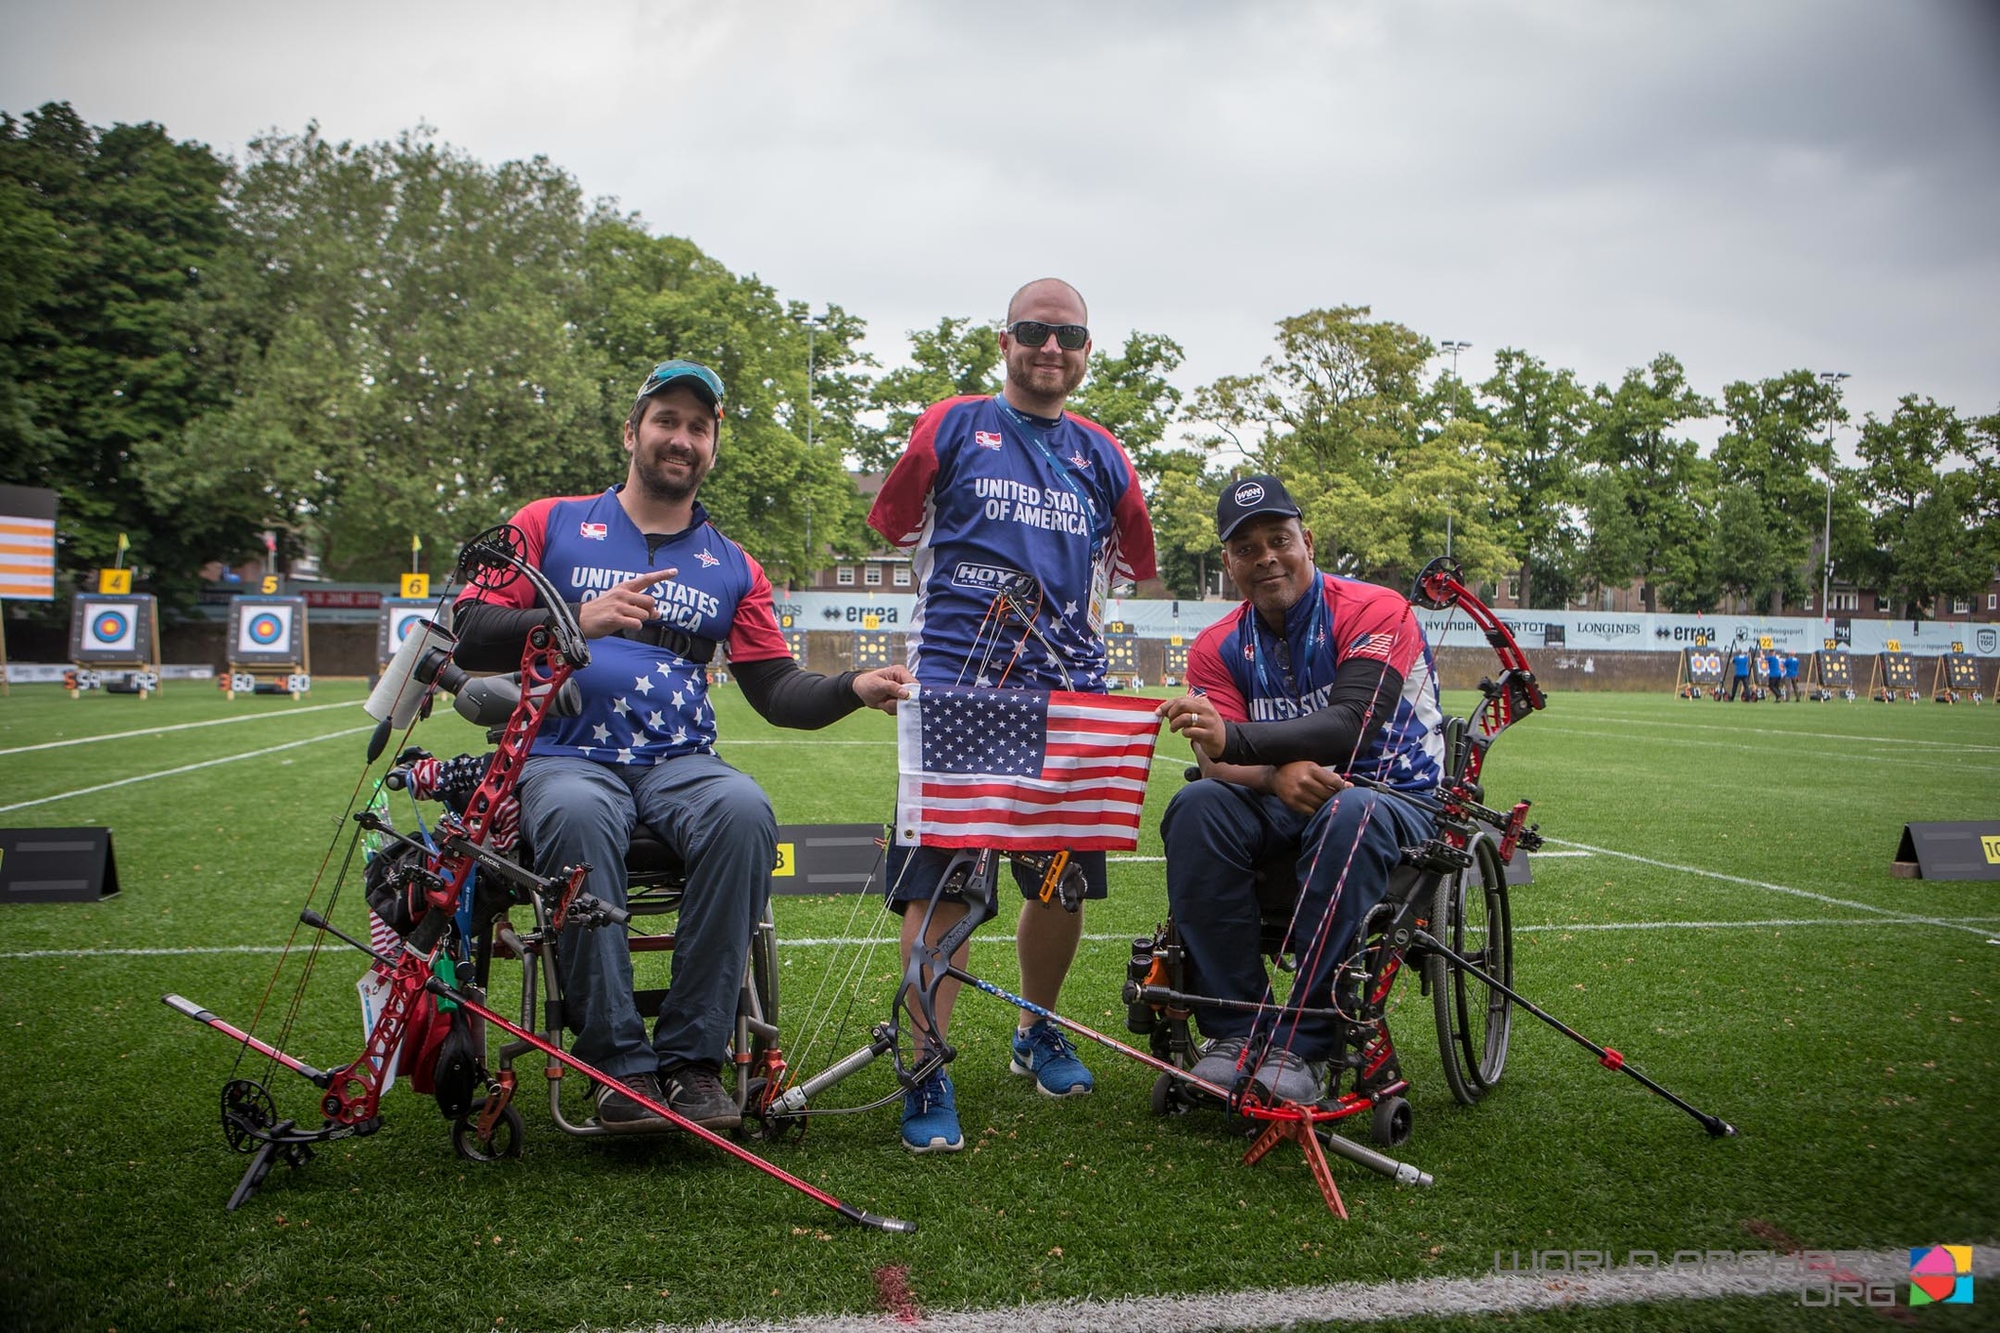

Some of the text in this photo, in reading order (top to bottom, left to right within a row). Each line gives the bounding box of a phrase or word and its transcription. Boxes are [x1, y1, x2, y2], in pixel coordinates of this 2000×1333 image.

[975, 478, 1040, 506] UNITED
[1043, 488, 1096, 516] STATS
[985, 499, 1010, 521] OF
[1012, 502, 1088, 537] AMERICA
[110, 575, 121, 590] 4
[261, 576, 278, 594] 5
[409, 579, 422, 594] 6
[651, 579, 720, 618] STATES
[846, 605, 898, 623] errea
[782, 615, 792, 627] 9
[865, 617, 878, 628] 10
[1425, 621, 1477, 631] HYUNDAI
[1111, 622, 1124, 633] 13
[1577, 622, 1641, 634] LONGINES
[1696, 635, 1706, 646] 21
[1761, 637, 1772, 647] 22
[1825, 641, 1836, 650] 23
[1888, 641, 1900, 650] 24
[478, 854, 501, 869] AXCEL
